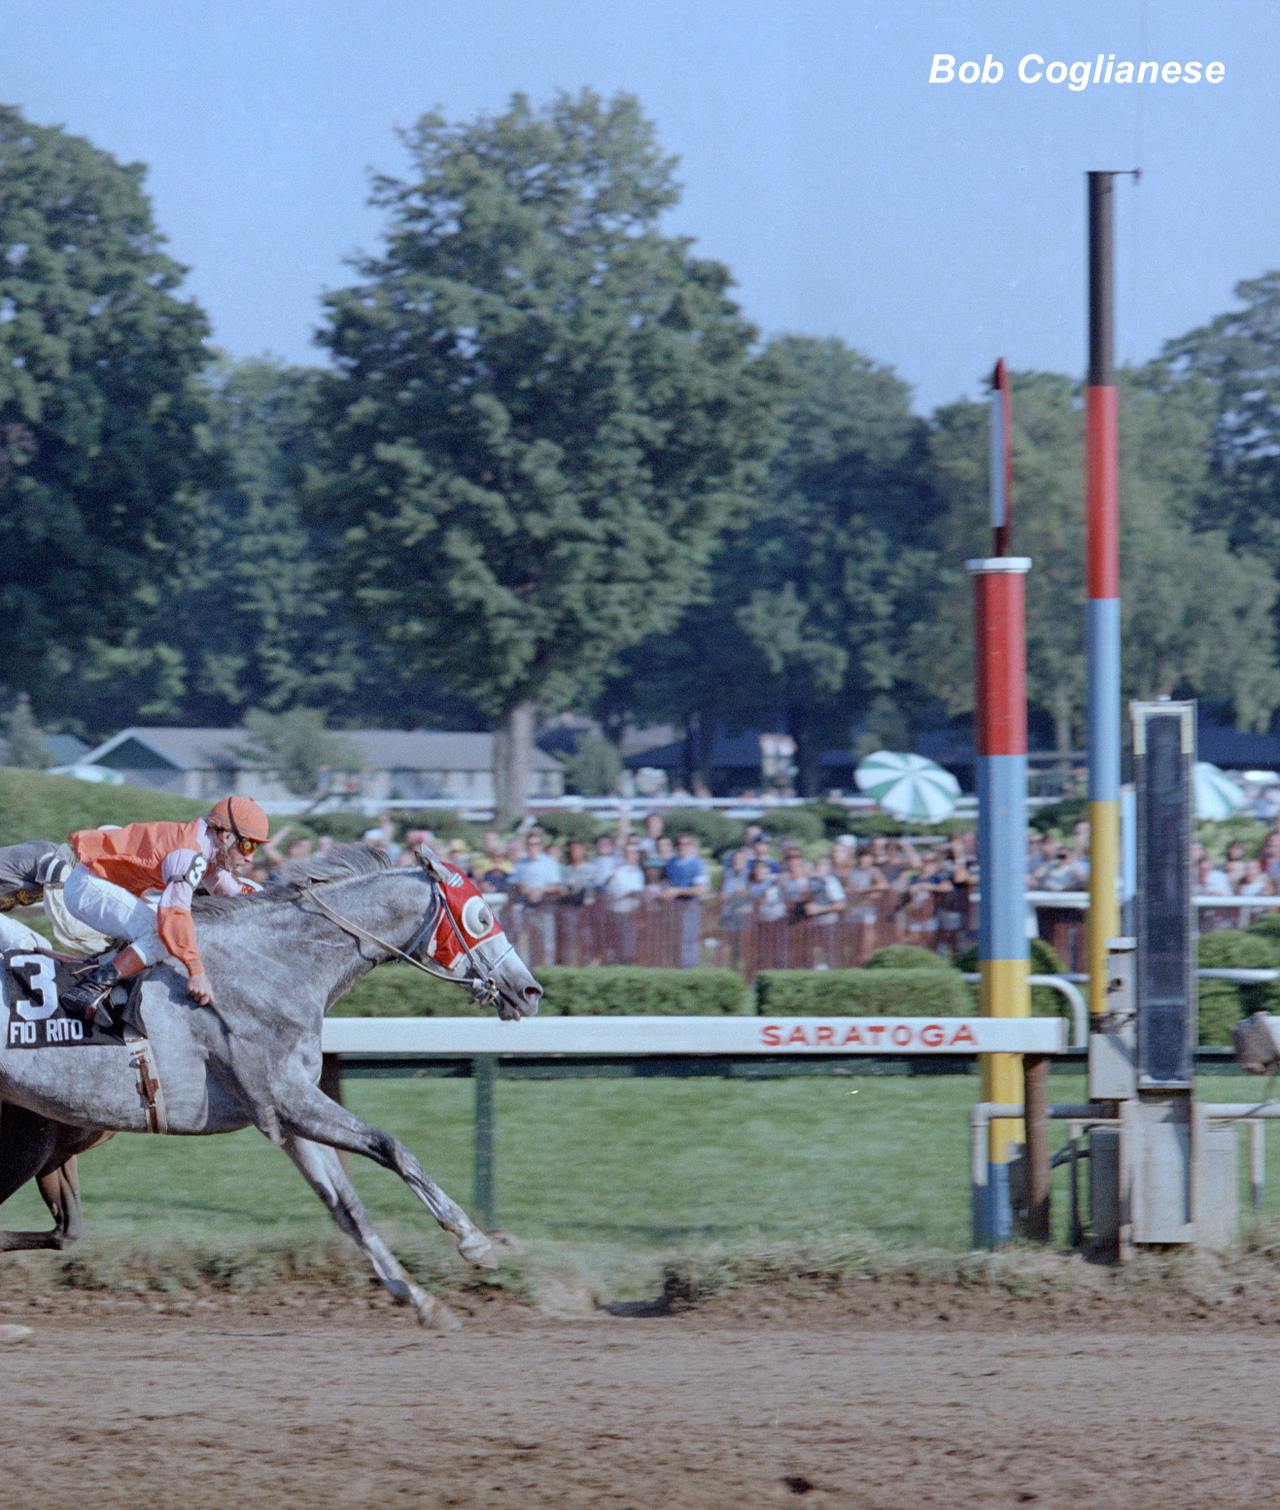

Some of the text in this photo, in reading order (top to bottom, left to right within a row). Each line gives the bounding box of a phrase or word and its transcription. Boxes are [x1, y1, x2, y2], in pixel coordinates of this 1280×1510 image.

[10, 954, 59, 1021] 3
[9, 1017, 84, 1044] FIO RITO
[760, 1023, 979, 1048] SARATOGA
